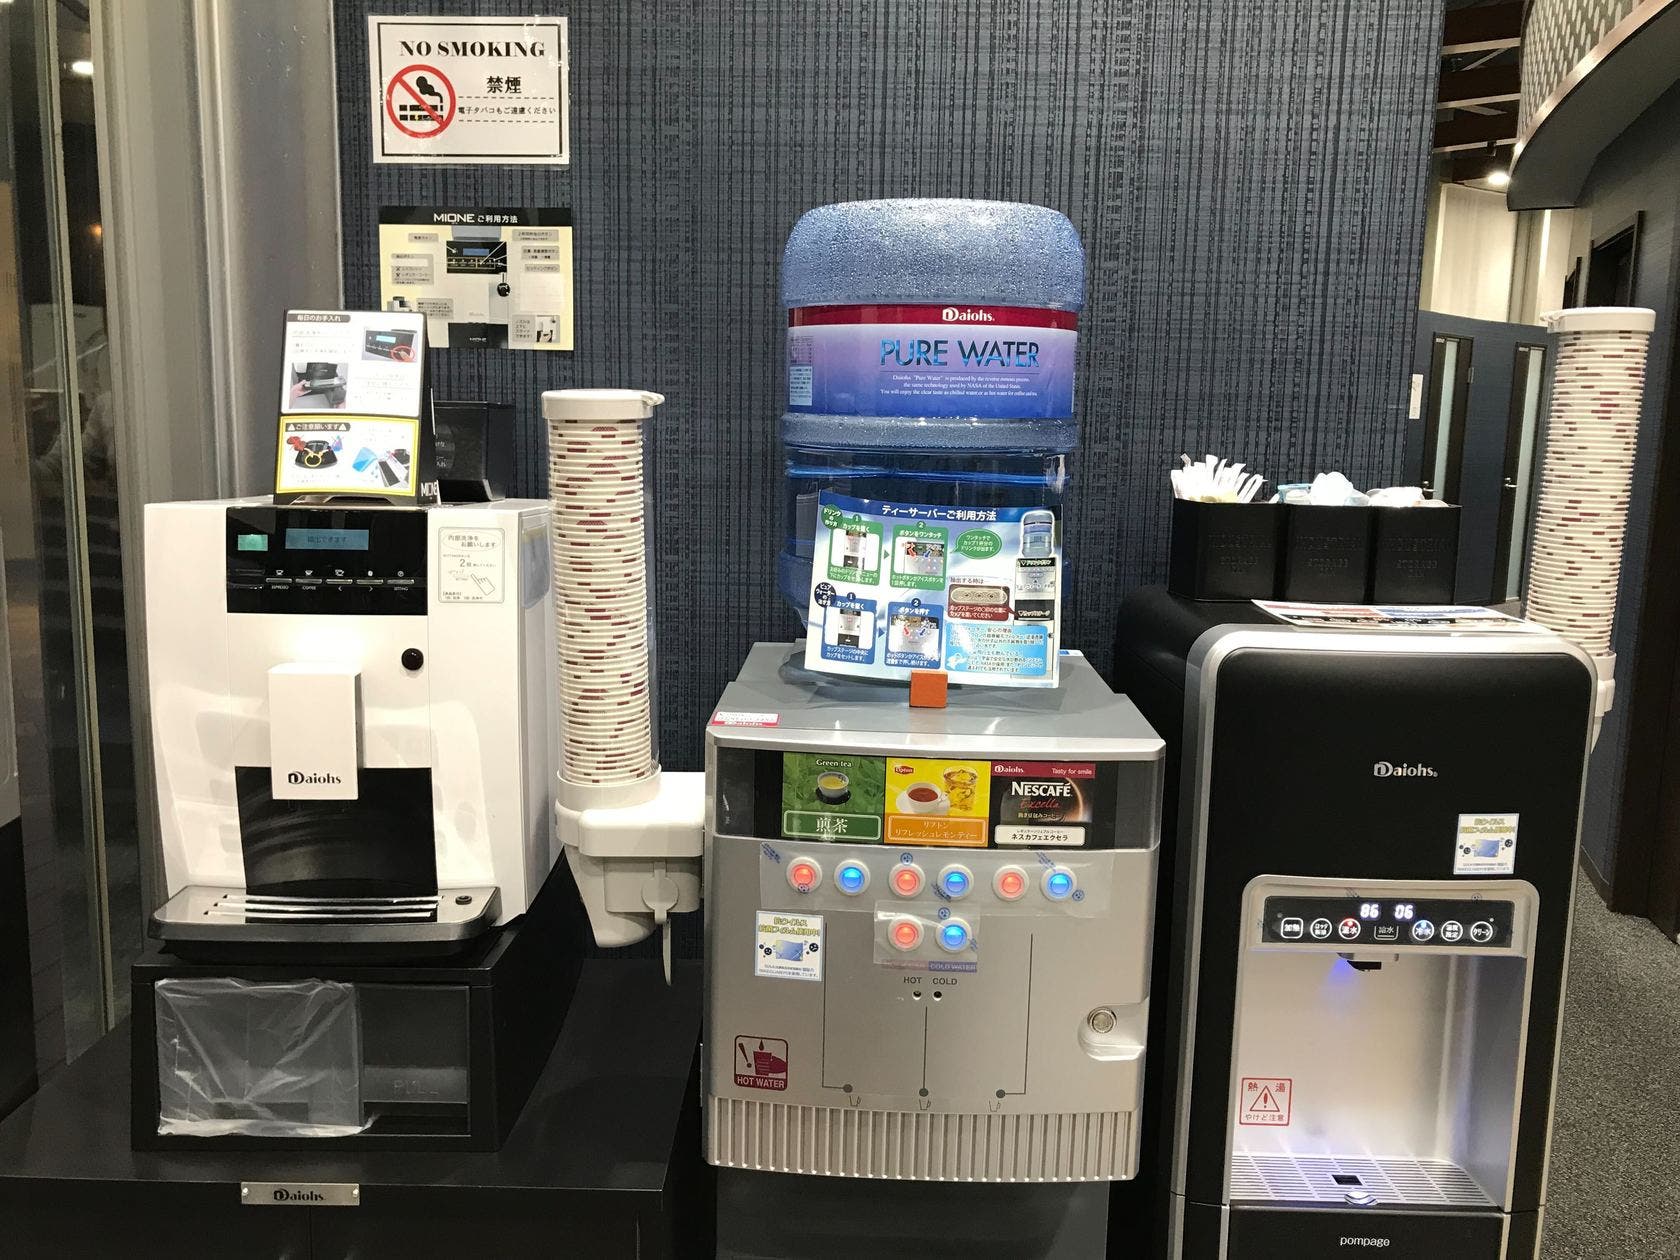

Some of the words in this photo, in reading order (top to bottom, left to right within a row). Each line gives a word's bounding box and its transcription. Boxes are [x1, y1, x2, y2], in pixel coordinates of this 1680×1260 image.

[400, 40, 431, 57] NO
[438, 40, 545, 57] SMOKING
[486, 76, 522, 94] 禁煙
[458, 107, 556, 115] 電子タバコもご遠慮ください
[433, 213, 475, 223] MIONE
[477, 214, 518, 224] ご利用方法
[297, 314, 341, 322] 毎日のお手入れ
[880, 339, 948, 366] PURE
[957, 340, 1040, 367] WATER
[823, 508, 842, 516] ドリンク
[882, 504, 997, 521] ティーサーバーご利用方法
[899, 530, 942, 539] ボタンをワンタッチ
[898, 606, 930, 615] ボタンを押す
[815, 759, 839, 767] Green
[994, 764, 1024, 773] Daiohs
[288, 771, 341, 785] Daiohs
[1011, 781, 1072, 797] NESCAFÉ
[815, 817, 848, 833] 煎茶
[895, 829, 977, 839] リフレッシュレモンティー
[1011, 833, 1068, 841] ネスカフェエクセラ
[1473, 928, 1490, 936] クリーン
[903, 976, 922, 984] HOT
[932, 977, 958, 985] COLD
[737, 1076, 755, 1085] HOT
[756, 1078, 785, 1088] WATER
[1245, 1113, 1284, 1121] やけど注意
[273, 1188, 324, 1201] Daiohs
[1340, 1236, 1390, 1247] pompage
